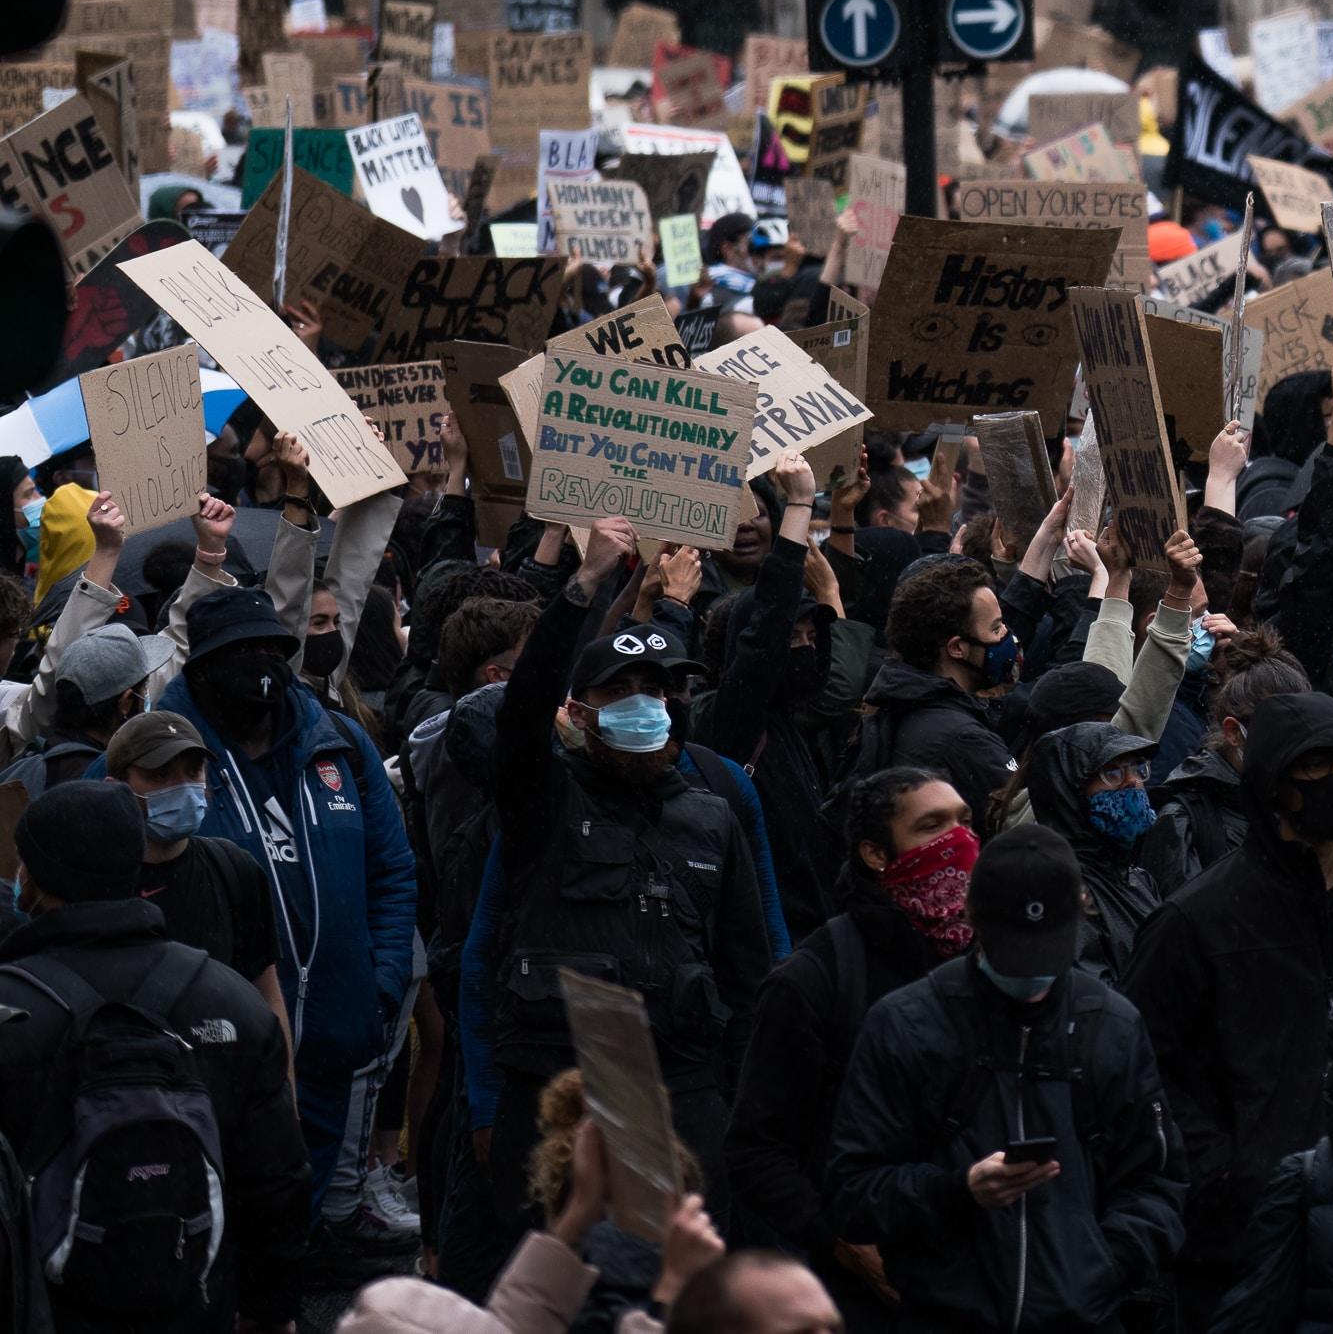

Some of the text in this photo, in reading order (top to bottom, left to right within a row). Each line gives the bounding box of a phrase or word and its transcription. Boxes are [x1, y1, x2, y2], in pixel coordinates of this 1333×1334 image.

[511, 8, 573, 32] LIVES
[495, 36, 532, 59] SAY
[499, 58, 581, 88] NAMES
[449, 92, 485, 128] IS
[251, 134, 350, 174] SIENCE
[352, 117, 422, 155] BLACK LIVES
[547, 139, 591, 168] BLA
[0, 114, 115, 217] ENCE
[361, 144, 435, 187] MATTER!
[48, 192, 87, 243] S
[555, 183, 635, 213] HOW MANY
[962, 185, 1145, 218] OPEN YOUR EYES
[566, 235, 629, 261] FILMED
[308, 263, 395, 318] EQUAL
[401, 257, 562, 309] BLACK
[933, 253, 1068, 313] History
[1168, 249, 1221, 295] BLACK
[160, 260, 267, 329] BLACK
[584, 312, 645, 357] WE
[966, 312, 1008, 353] Is
[1265, 298, 1319, 342] ACK
[236, 343, 323, 394] LIVES
[700, 346, 782, 384] ENCE
[1264, 337, 1310, 372] IVES
[105, 353, 201, 437] SILENCE
[336, 365, 444, 390] UNDERSTA
[378, 384, 437, 409] NEVER
[551, 357, 730, 417] YOU CAN KILL
[888, 359, 1036, 409] Watching
[542, 390, 740, 453] A REVOLUTIONARY
[749, 382, 865, 463] ETRAYAL
[157, 435, 173, 469] IS
[298, 410, 401, 481] MATTER
[405, 439, 443, 472] YO
[539, 424, 745, 489] BUT YOU CAN'T KILL
[120, 452, 206, 519] VIOLENCE
[609, 464, 649, 481] THE
[539, 466, 729, 537] REVOLUTION
[326, 801, 357, 812] Emirates
